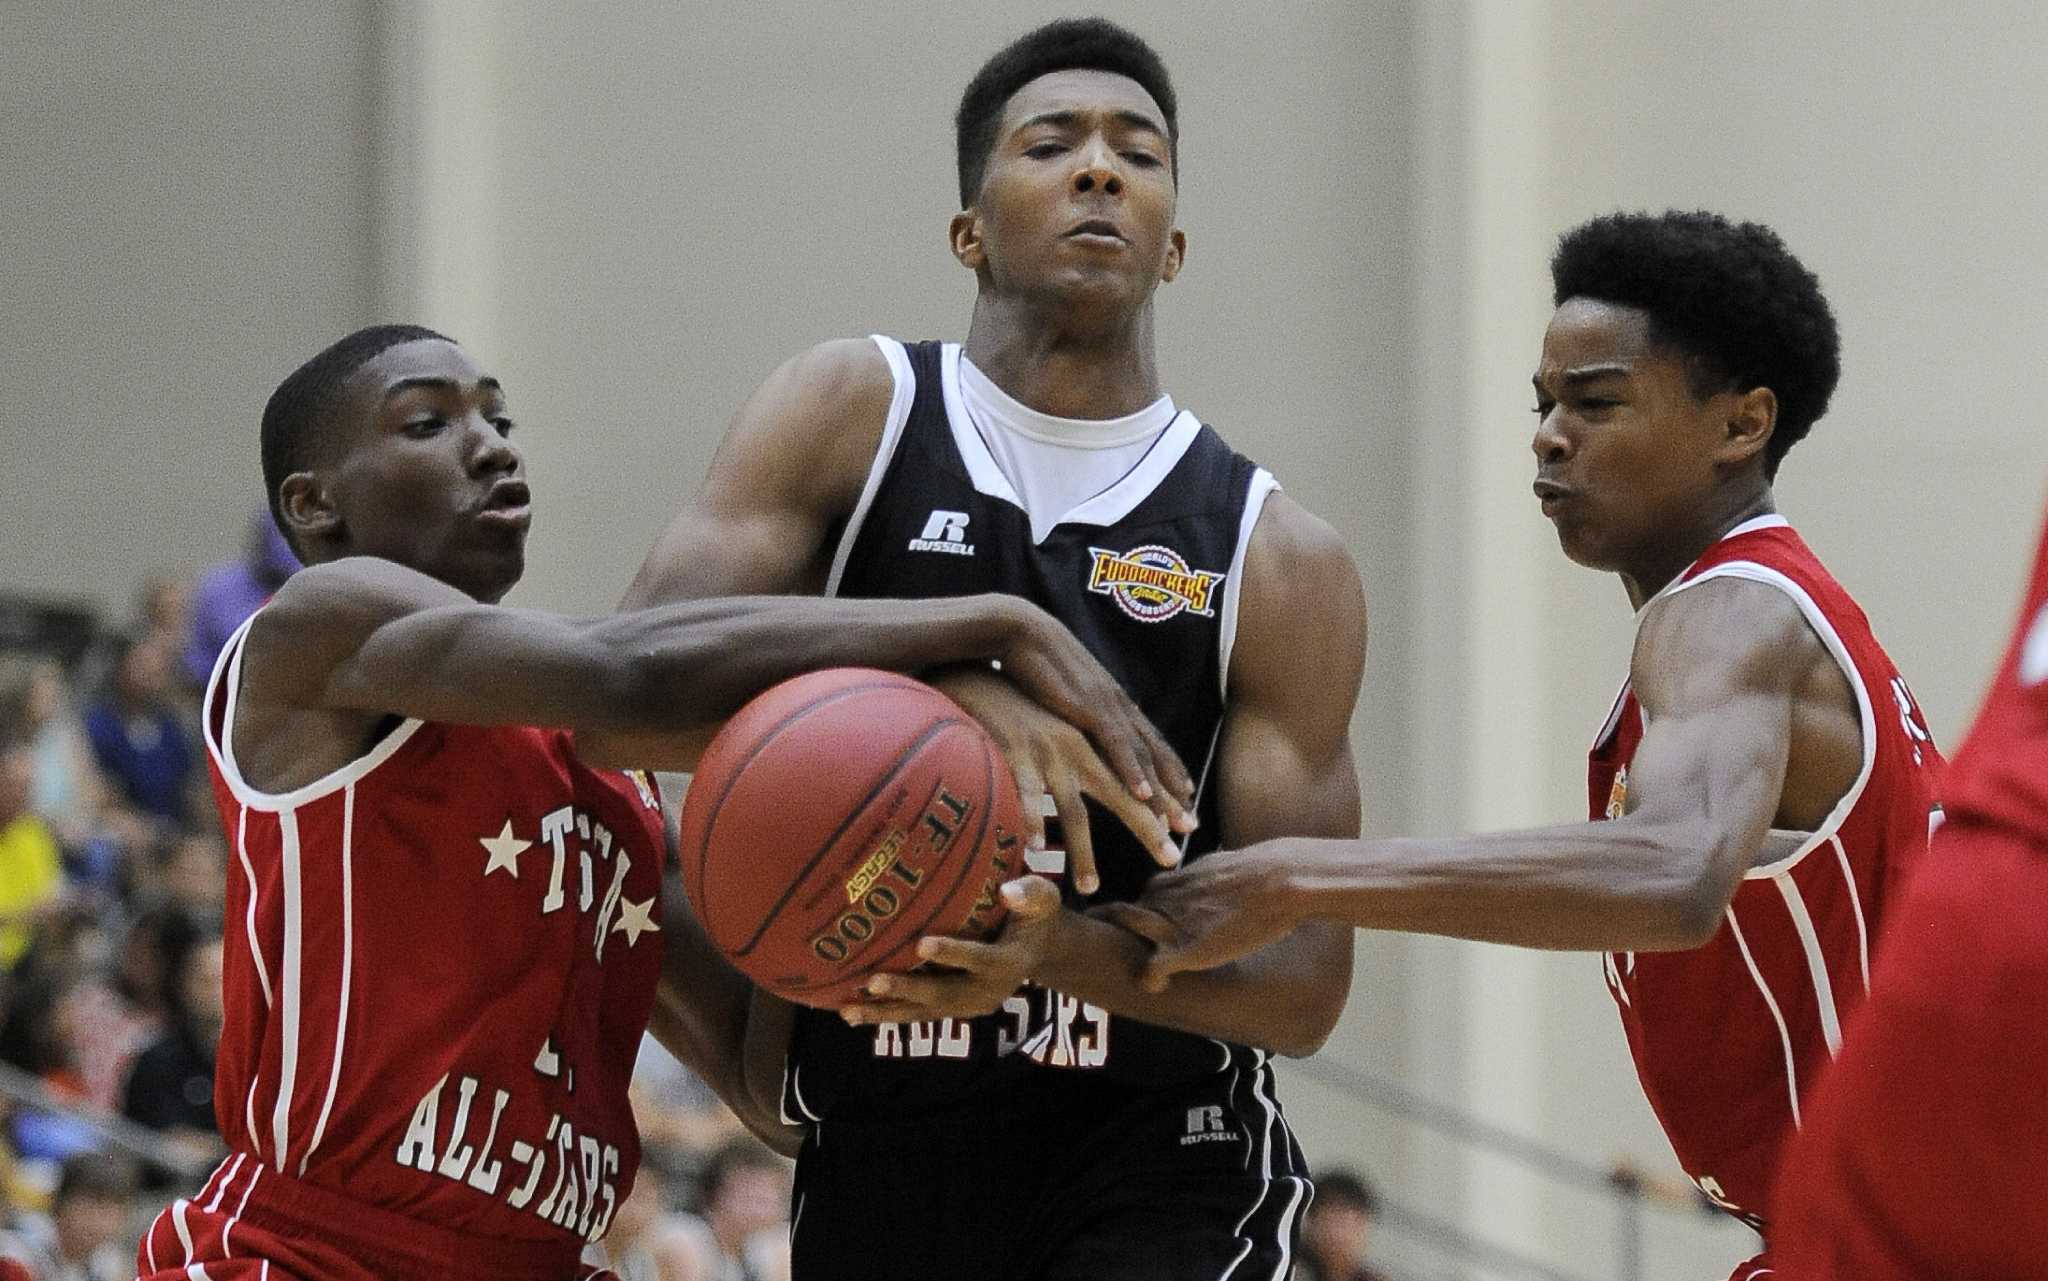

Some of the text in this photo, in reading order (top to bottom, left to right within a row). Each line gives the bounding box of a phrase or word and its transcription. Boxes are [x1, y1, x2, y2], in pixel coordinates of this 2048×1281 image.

[908, 538, 975, 556] RUSSELL
[1093, 553, 1210, 611] FUDDRUCKERS
[845, 830, 905, 904] LEGACY
[1180, 1131, 1240, 1145] RUSSELL
